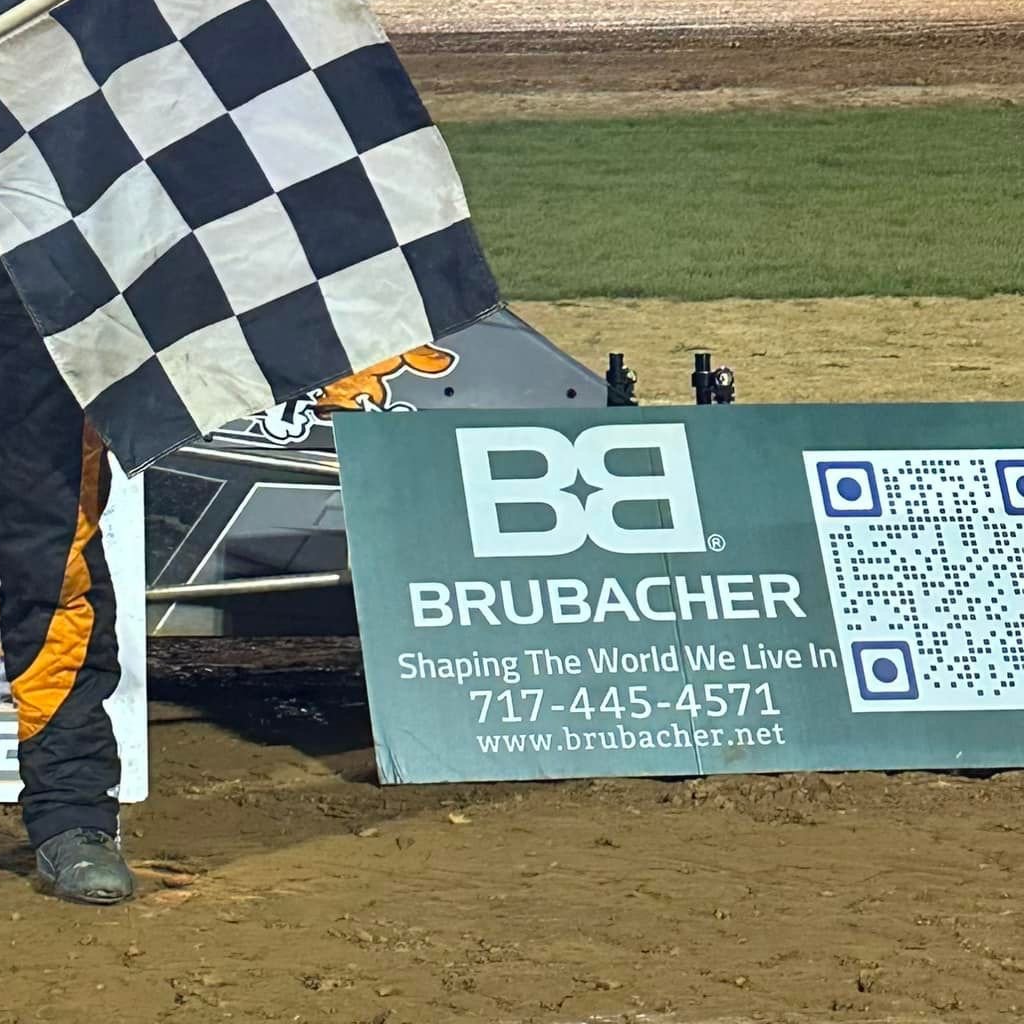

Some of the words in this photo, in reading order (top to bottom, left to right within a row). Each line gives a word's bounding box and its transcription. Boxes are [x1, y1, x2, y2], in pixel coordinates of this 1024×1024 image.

[408, 573, 807, 628] BRUBACHER
[398, 651, 520, 685] Shaping
[525, 649, 582, 675] The
[587, 645, 678, 674] World
[685, 647, 736, 672] We
[743, 643, 802, 670] Live
[809, 642, 837, 669] In
[469, 682, 781, 724] 717-445-4571
[476, 722, 786, 753] www.brubacher.net
